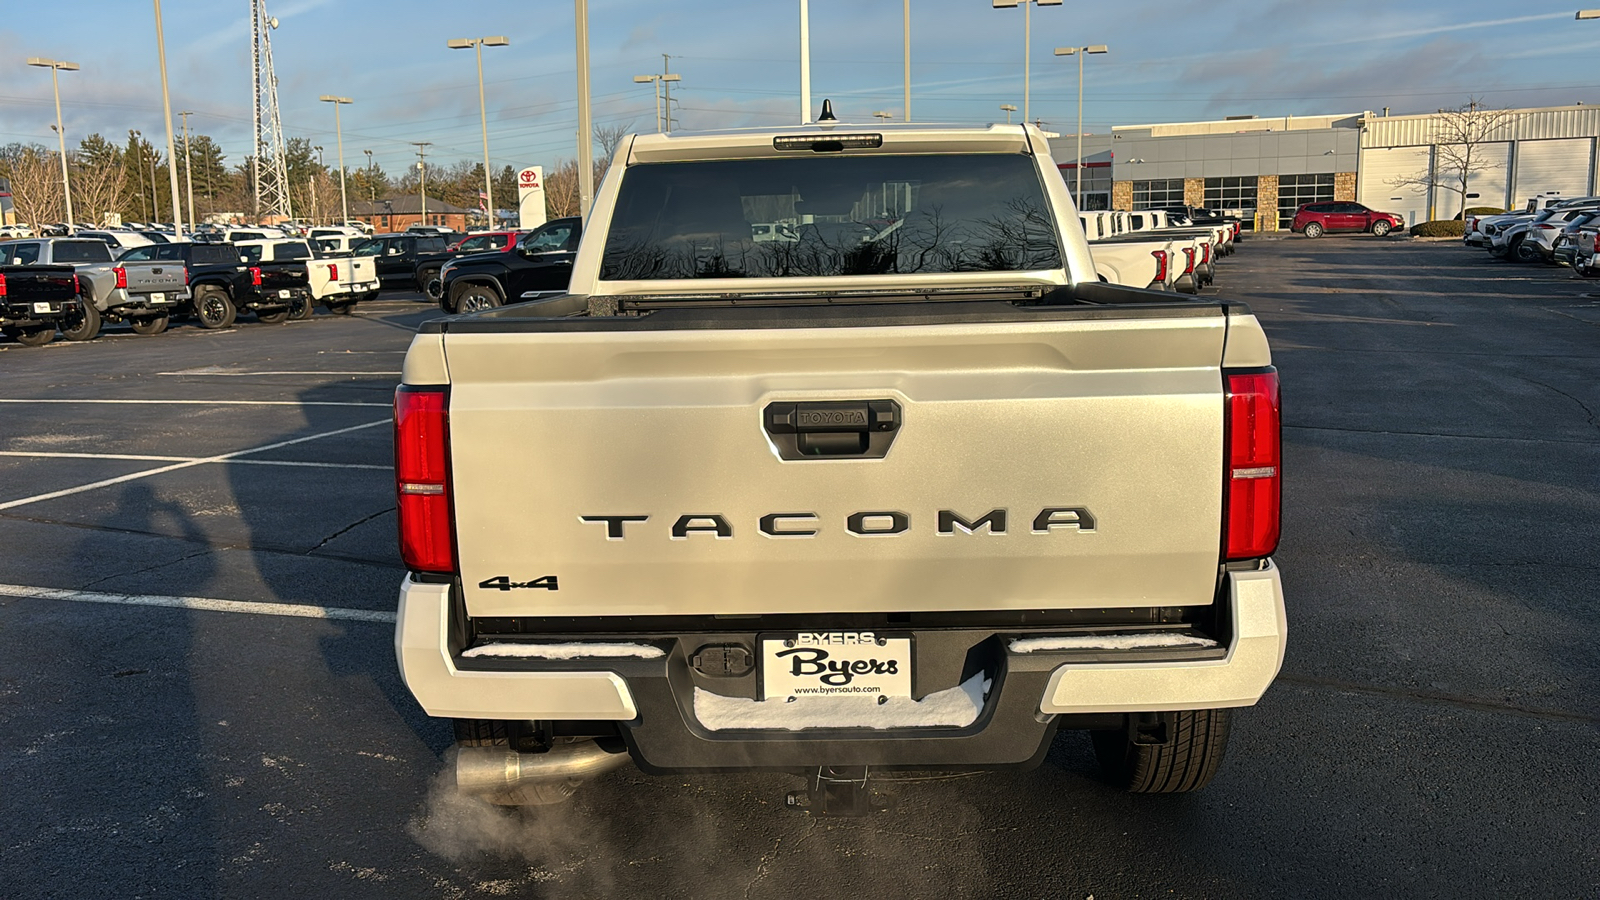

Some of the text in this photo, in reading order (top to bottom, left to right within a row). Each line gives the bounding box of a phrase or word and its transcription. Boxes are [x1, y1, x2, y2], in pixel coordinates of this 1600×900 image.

[801, 411, 865, 424] TOYOTA
[578, 507, 1097, 539] TACOMA
[797, 632, 876, 645] BYERS
[775, 647, 899, 686] Byers
[794, 685, 881, 695] www.byersauto.com
